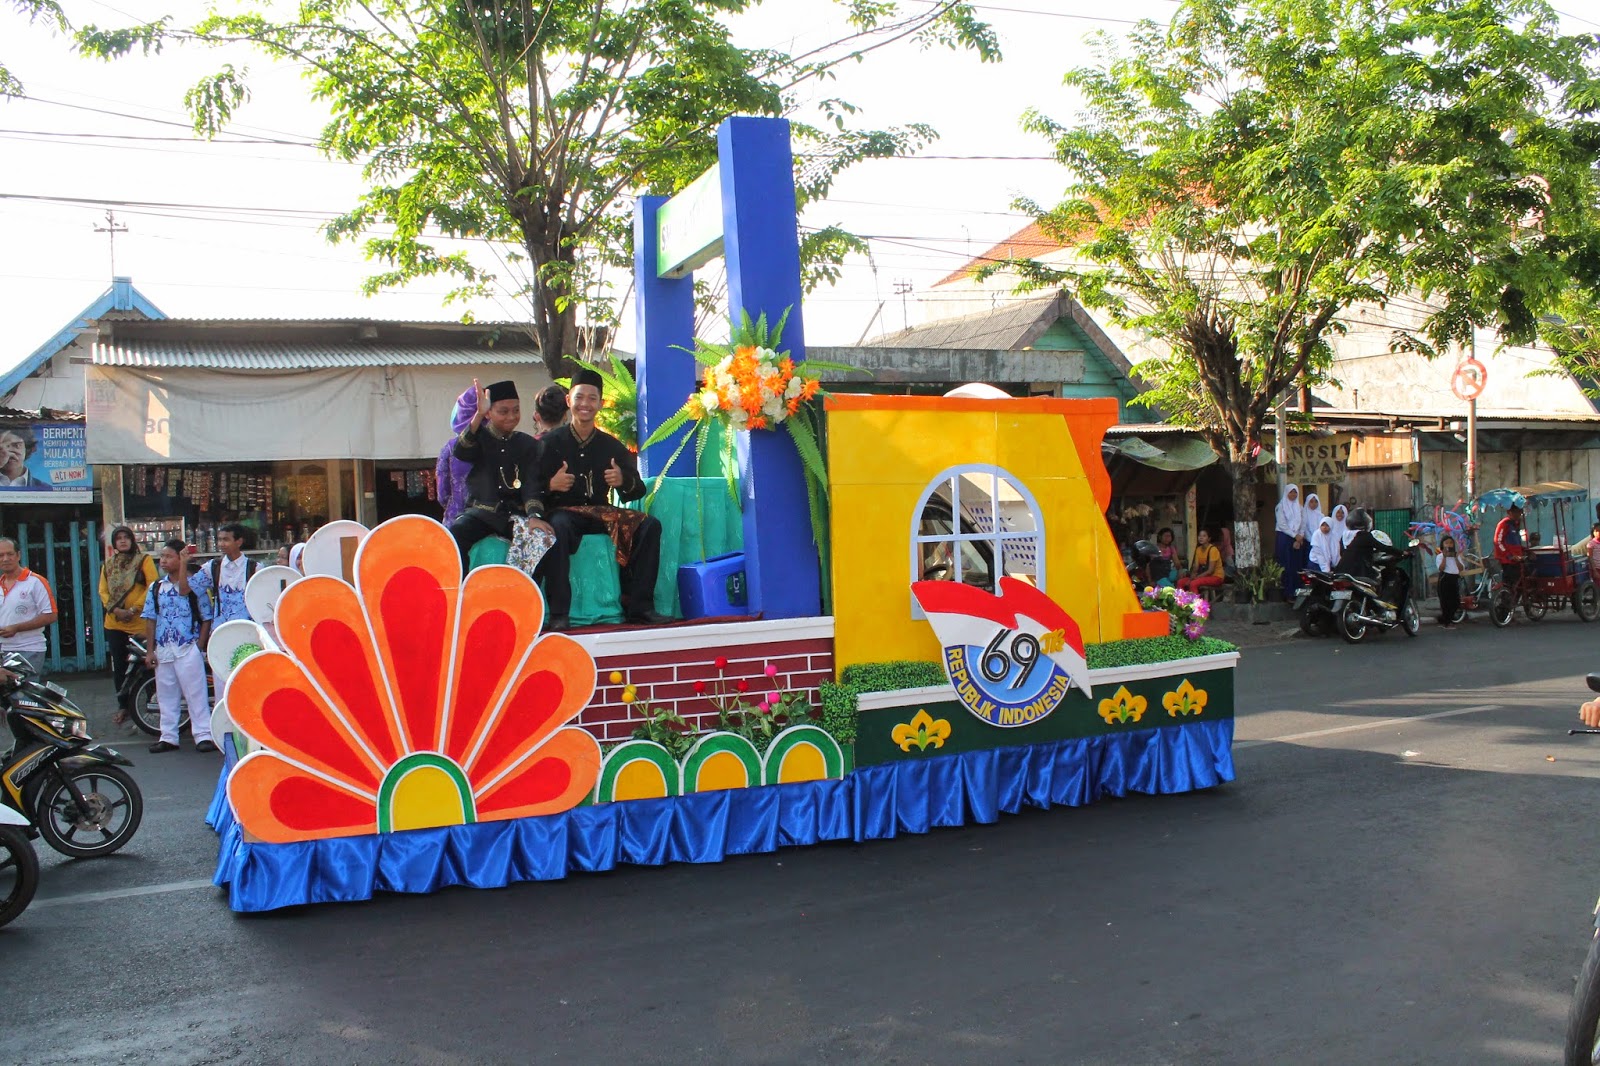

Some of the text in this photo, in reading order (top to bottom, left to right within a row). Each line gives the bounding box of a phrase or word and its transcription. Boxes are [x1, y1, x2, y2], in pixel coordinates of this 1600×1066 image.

[947, 647, 1069, 725] REPUBLIK INDONESIA
[981, 628, 1041, 690] 69
[18, 700, 39, 708] YAMAHA
